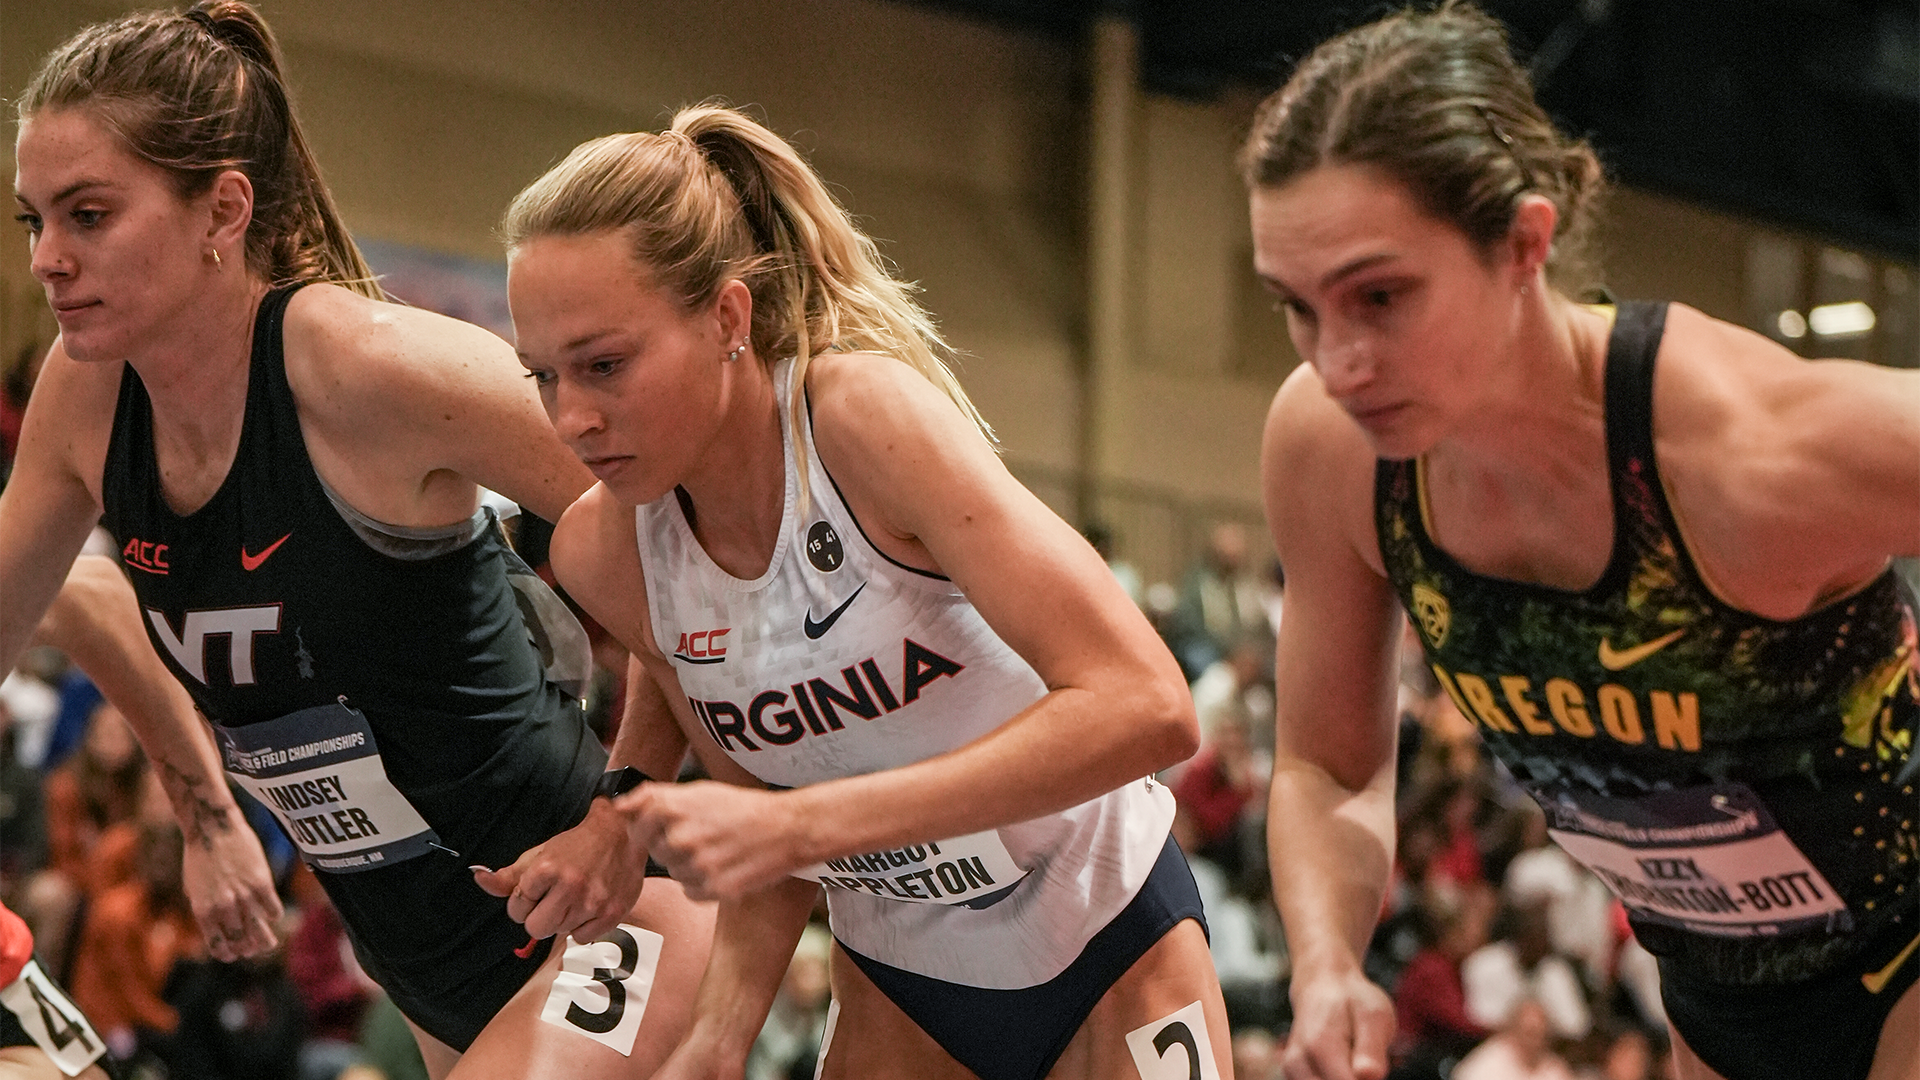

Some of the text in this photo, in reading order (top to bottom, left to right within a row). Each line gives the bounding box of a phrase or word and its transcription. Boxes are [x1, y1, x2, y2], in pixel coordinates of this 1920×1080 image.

[123, 538, 169, 568] ACC
[144, 602, 283, 687] VT
[675, 628, 732, 656] ACC
[261, 750, 287, 768] FIELD
[288, 732, 365, 761] CHAMPIONSHIPS
[1636, 857, 1704, 880] IZZY
[565, 927, 639, 1034] 3
[25, 976, 95, 1054] 4
